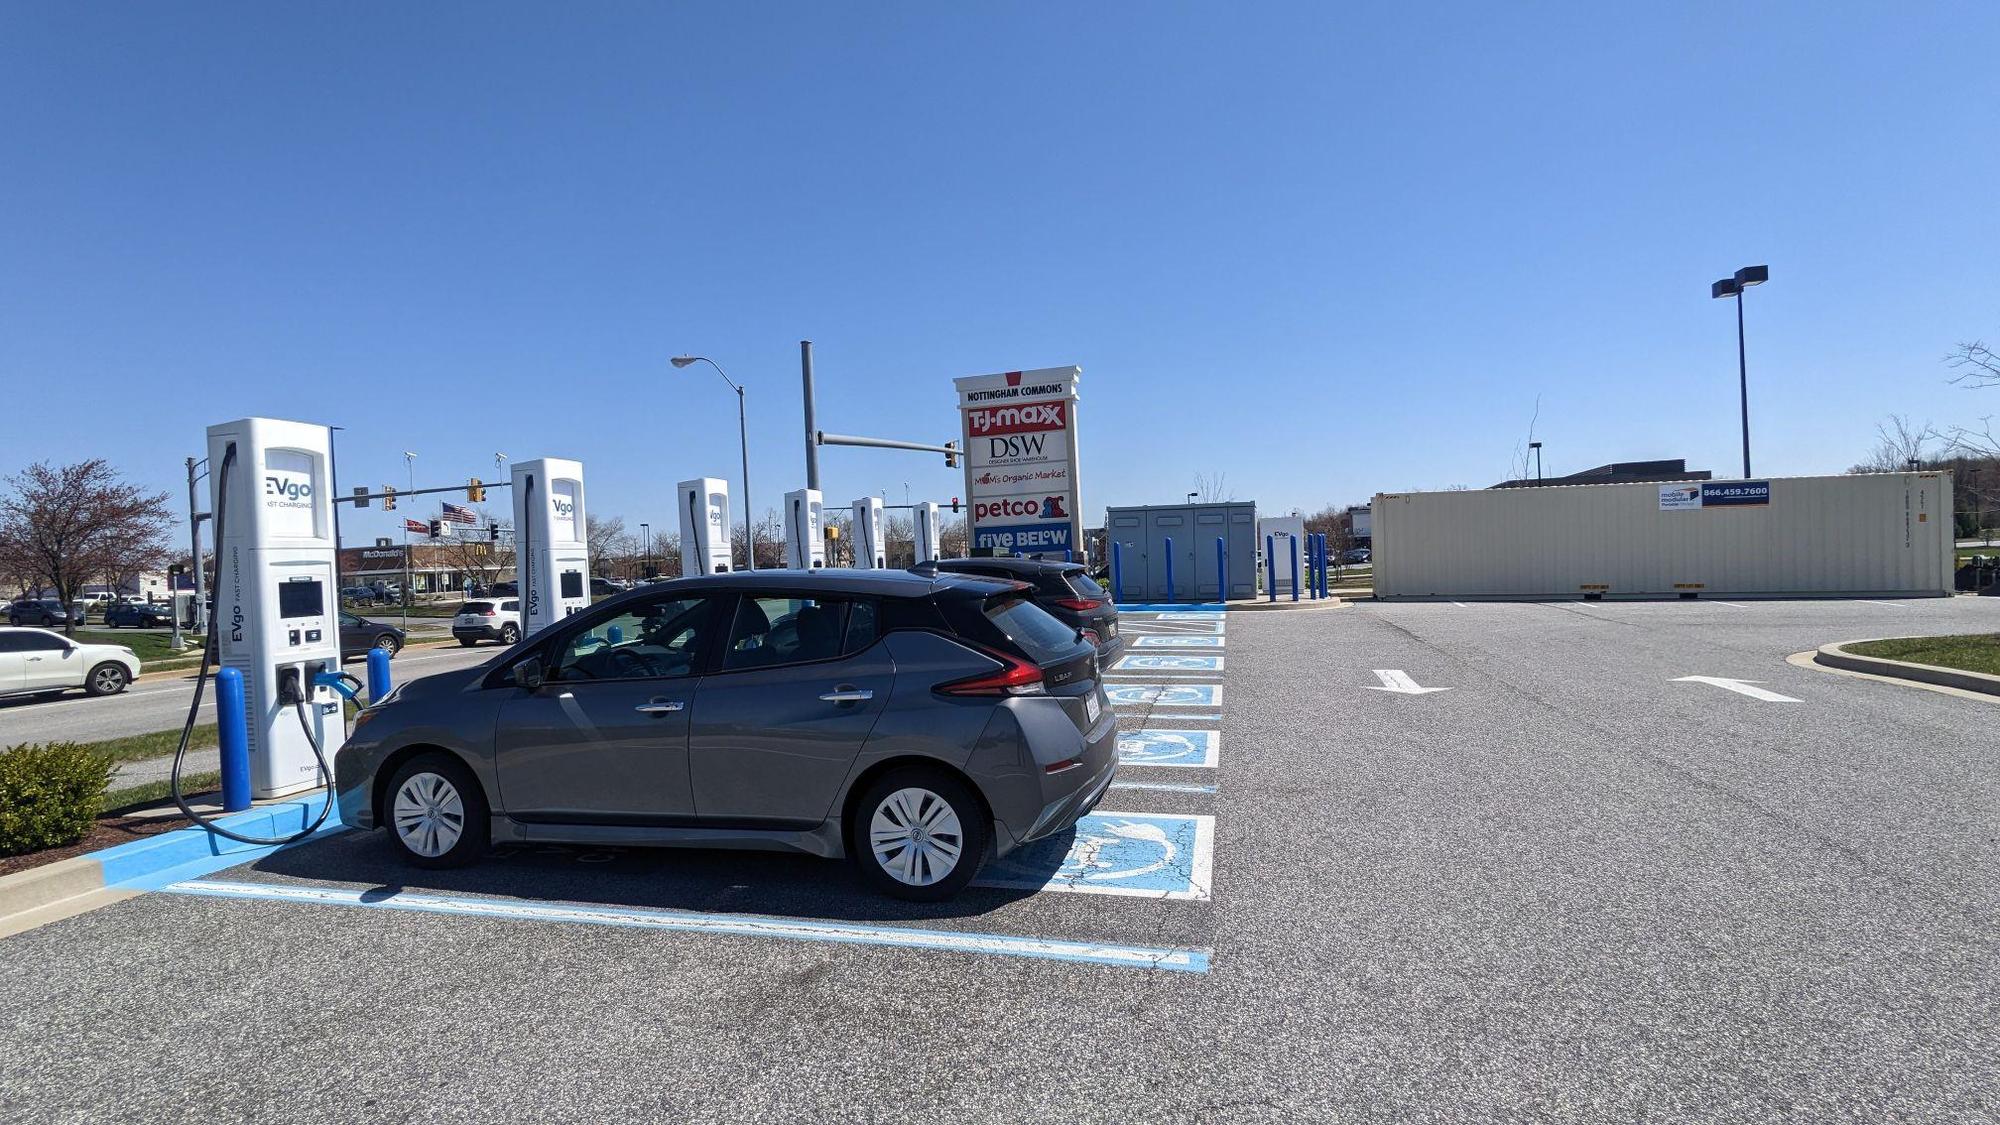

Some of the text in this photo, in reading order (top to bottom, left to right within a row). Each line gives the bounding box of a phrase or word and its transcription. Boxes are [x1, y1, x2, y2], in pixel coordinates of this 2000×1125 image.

[967, 383, 1063, 402] NOTTINGHAM COMMONS
[989, 433, 1047, 459] DSW
[1002, 472, 1034, 484] Organic
[1035, 469, 1067, 479] Market
[265, 476, 312, 501] EVgo
[1703, 486, 1768, 497] 866.459.7600
[552, 498, 574, 516] Vgo
[974, 499, 1039, 523] petco
[978, 532, 1014, 548] five
[362, 548, 405, 559] McDonald's
[530, 589, 540, 616] EVgo
[231, 605, 244, 642] EVgo
